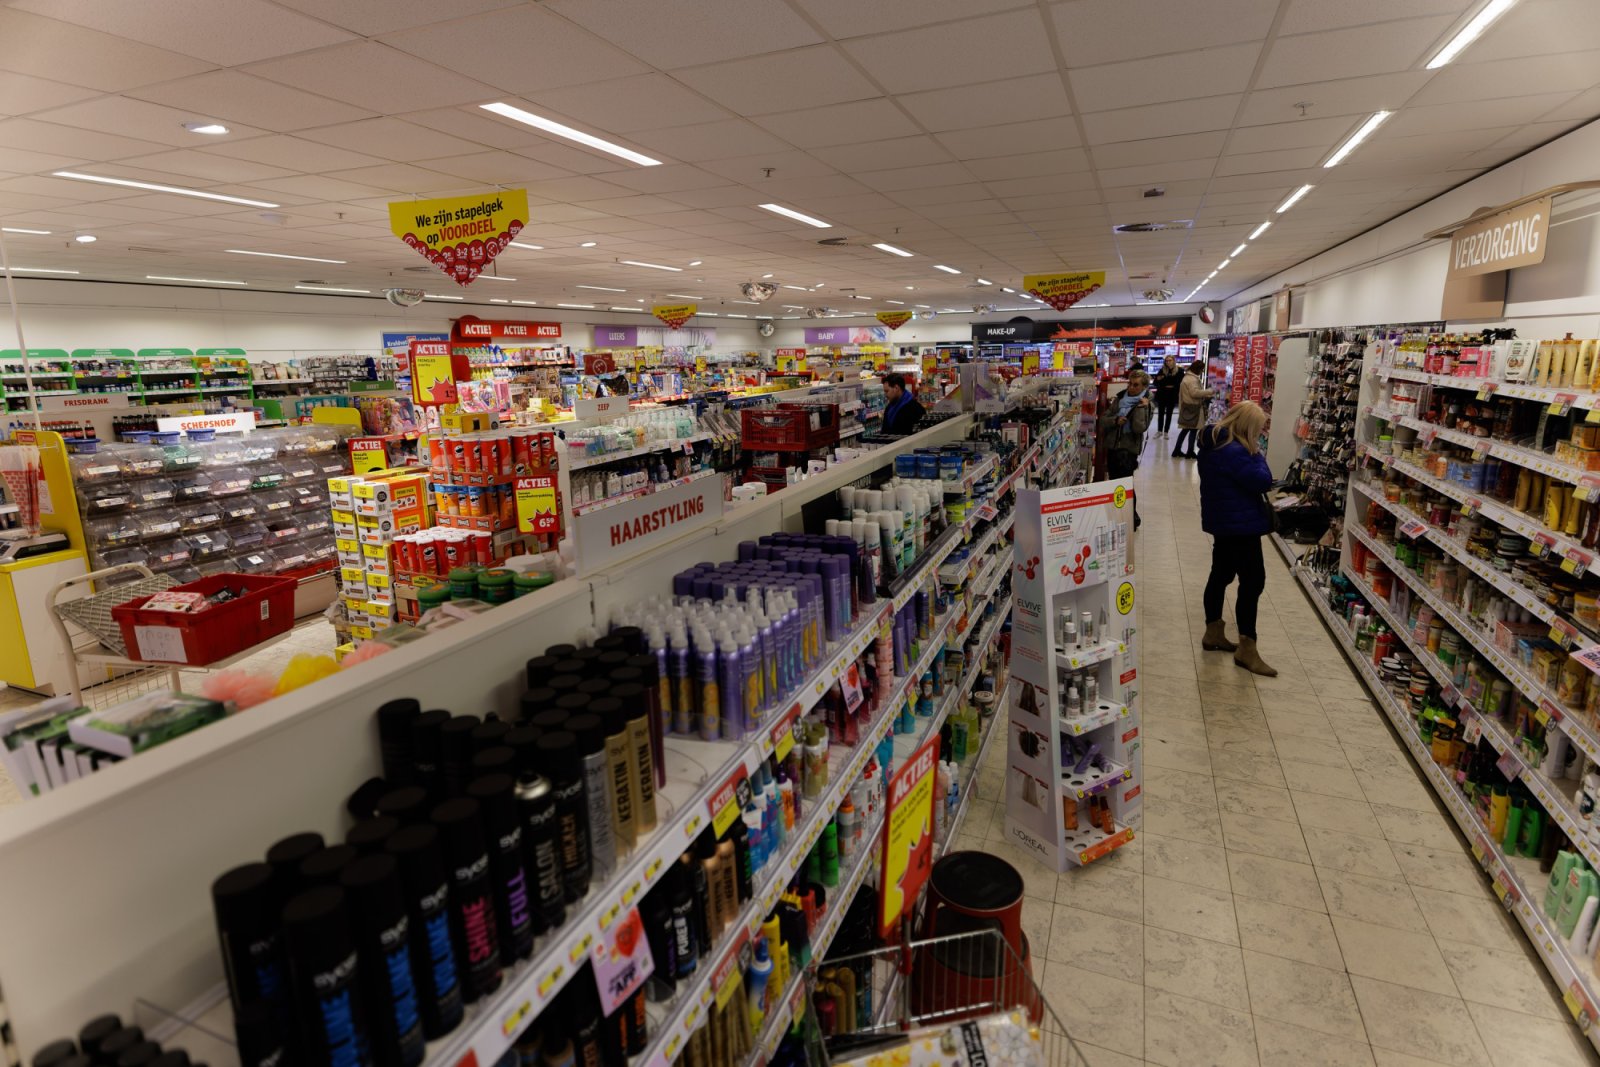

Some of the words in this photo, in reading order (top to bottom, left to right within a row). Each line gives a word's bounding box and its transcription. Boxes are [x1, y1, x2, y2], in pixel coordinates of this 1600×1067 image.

[416, 215, 431, 228] We
[434, 210, 452, 226] zijn
[455, 198, 504, 221] stapelgek
[426, 234, 439, 246] op
[440, 218, 496, 242] VOORDEEL
[1454, 213, 1541, 270] VERZORGING
[1050, 283, 1084, 293] VOORDEEL
[465, 324, 492, 335] ACTIE!
[504, 325, 527, 335] ACTIE!
[537, 326, 558, 336] ACTIE!
[987, 328, 1016, 336] MAKE-UP
[417, 344, 448, 354] ACTIE!
[1248, 339, 1265, 404] HAARKLEU
[64, 398, 109, 407] FRISDRANK
[180, 418, 237, 430] SCHEPSNOEP
[353, 441, 381, 450] ACTIE!
[518, 477, 551, 488] ACTIE!
[610, 496, 704, 547] HAARSTYLING
[1047, 514, 1072, 526] ELVIVE
[1017, 598, 1041, 613] ELVIVE
[638, 744, 652, 802] KERATIN
[893, 746, 934, 804] ACTIE!
[614, 761, 631, 823] KERATIN
[536, 839, 557, 900] SALON
[507, 867, 529, 927] FULL
[462, 896, 491, 962] SHINE
